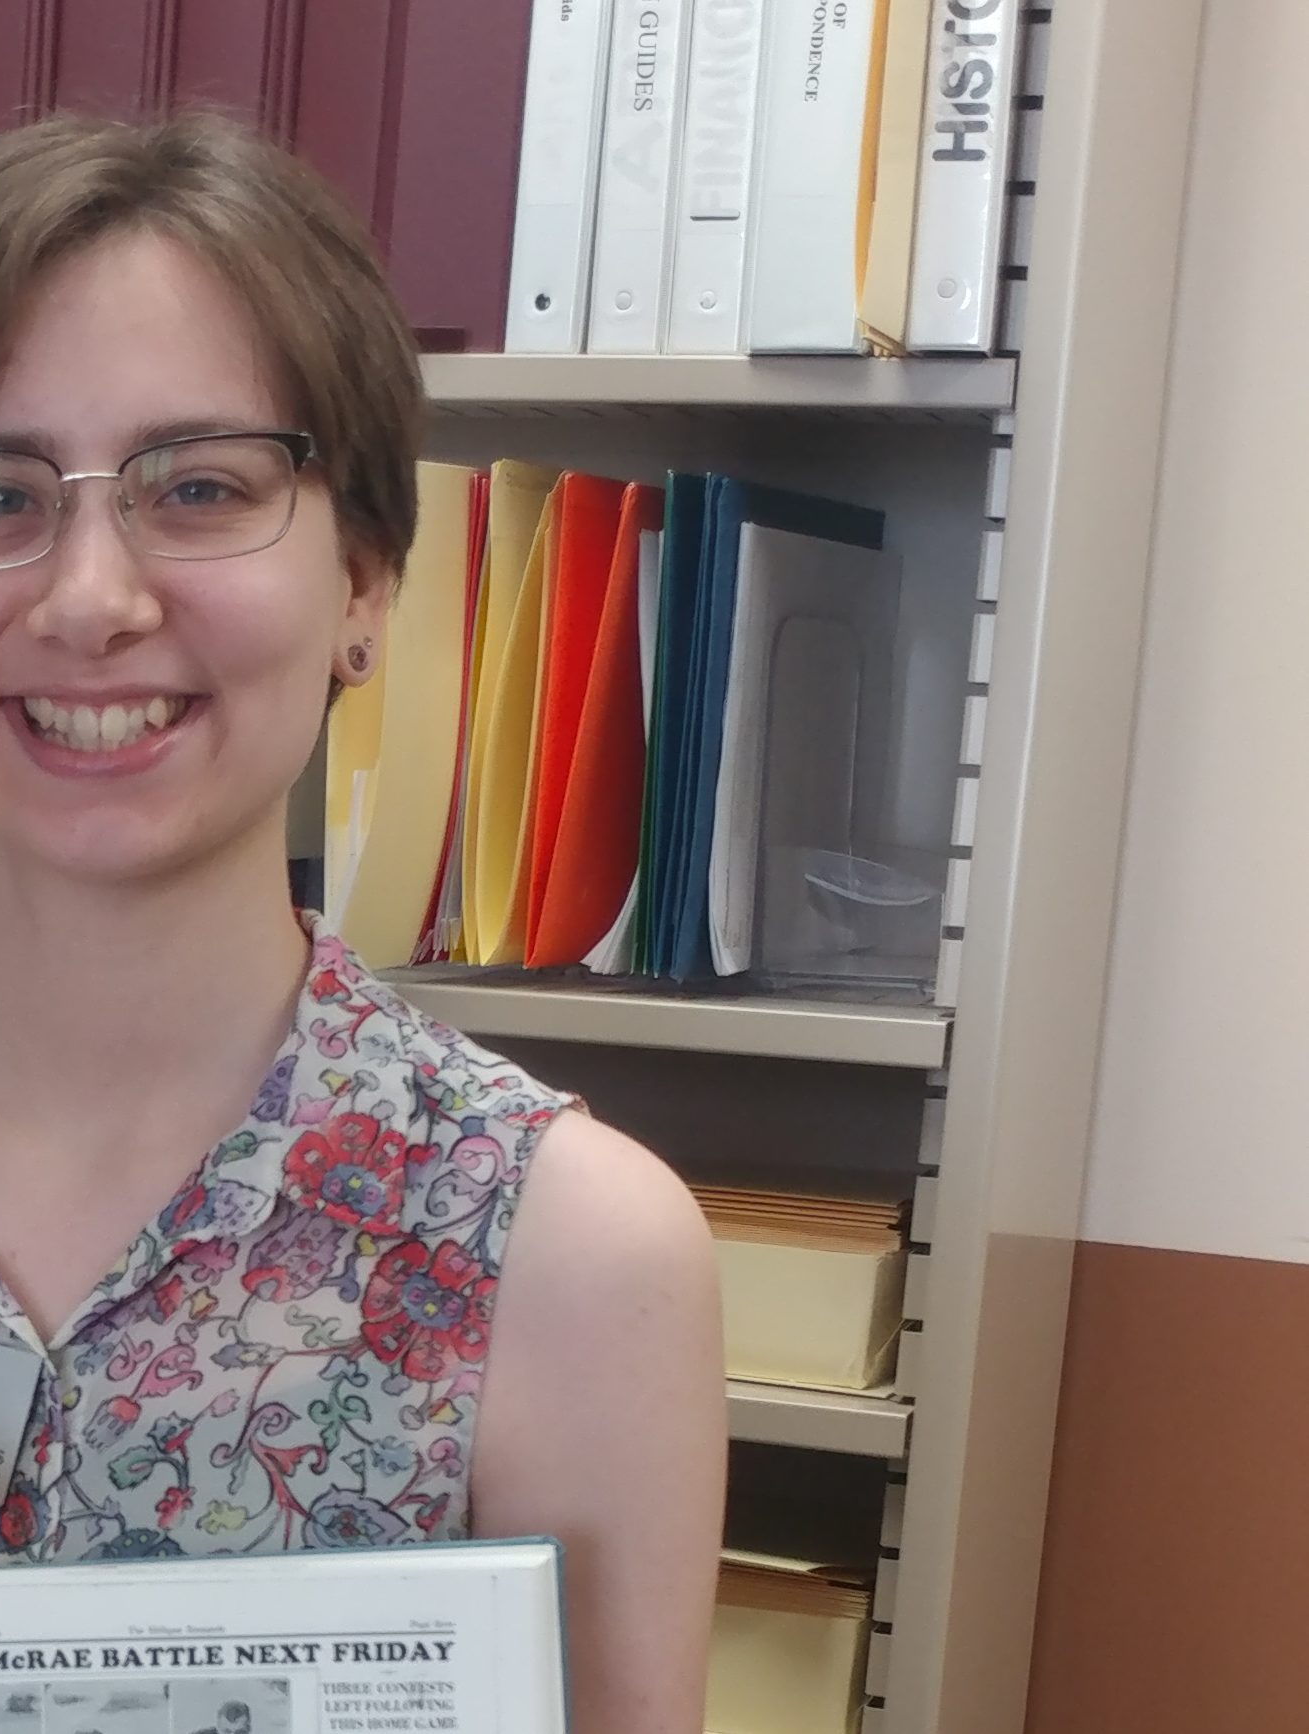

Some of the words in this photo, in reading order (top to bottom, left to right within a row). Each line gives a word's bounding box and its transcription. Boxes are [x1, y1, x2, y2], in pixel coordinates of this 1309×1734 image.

[832, 2, 848, 30] OF
[633, 10, 659, 112] GUIDES
[101, 1642, 225, 1669] BATTLE
[235, 1641, 321, 1667] NEXT
[332, 1639, 456, 1663] FRIDAY
[322, 1682, 371, 1696] THREE
[377, 1680, 456, 1695] CONTESTS
[366, 1698, 455, 1712] FOLLOWING
[367, 1716, 411, 1730] HOME
[414, 1716, 458, 1730] GAME
